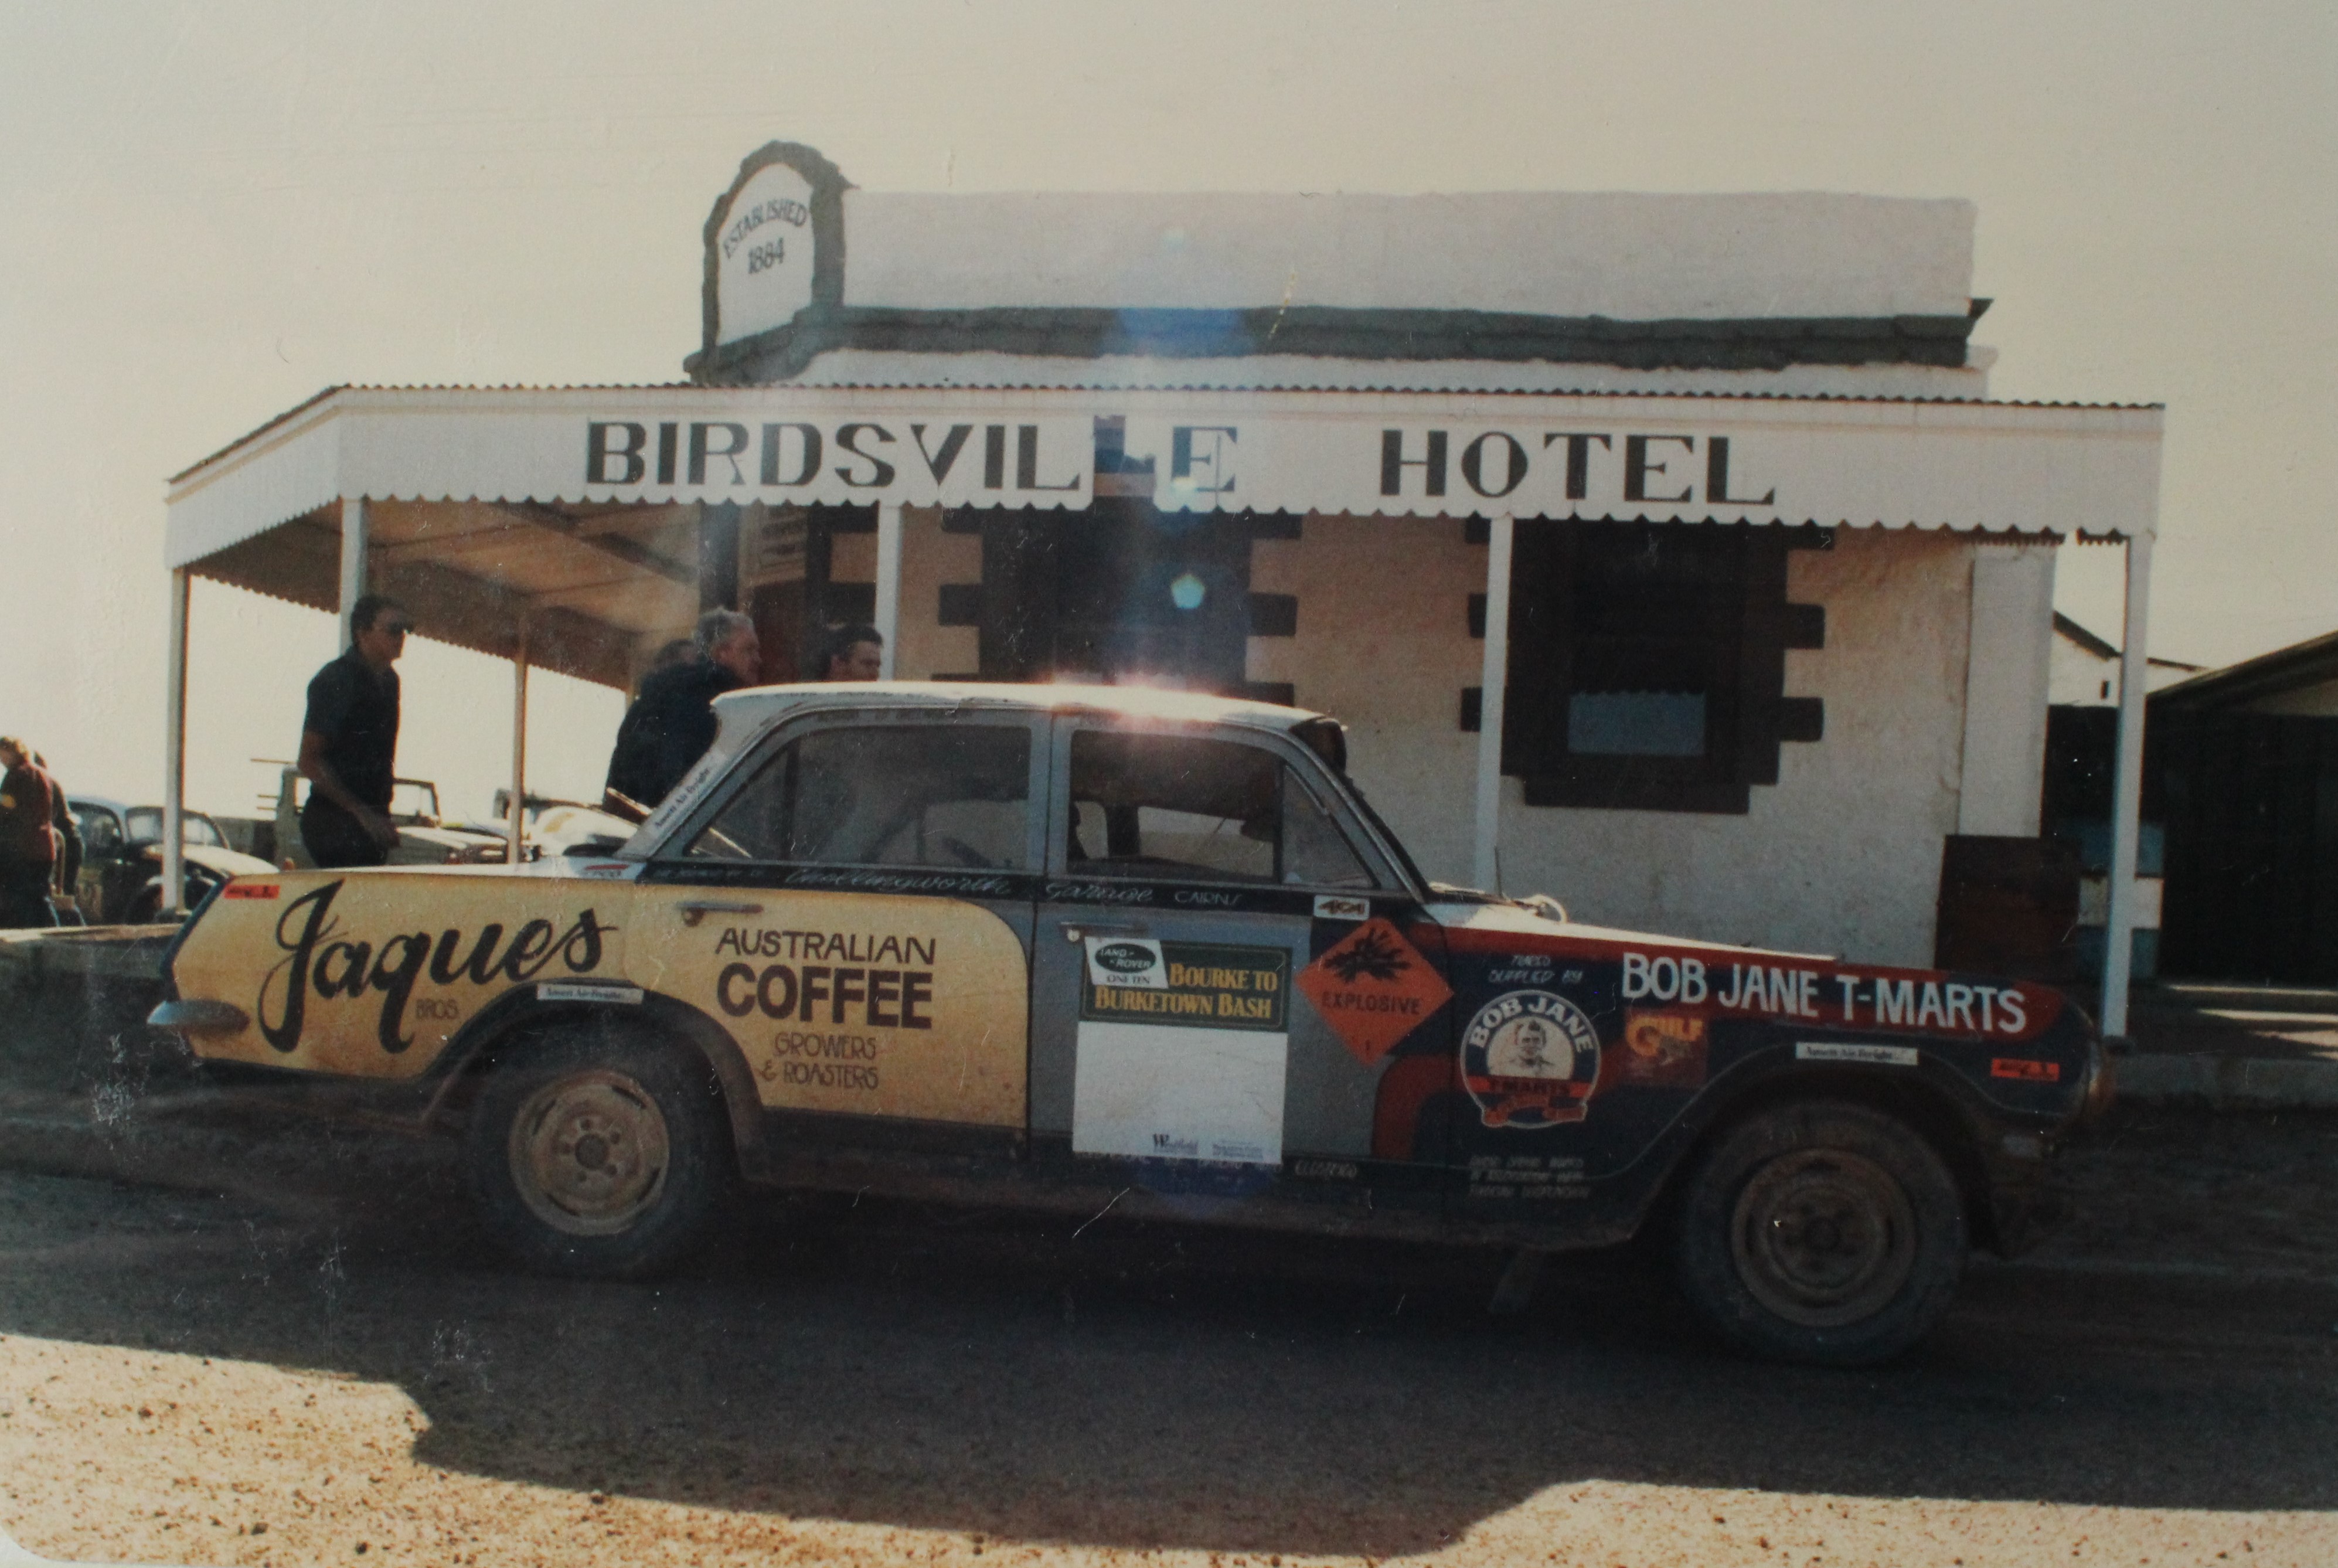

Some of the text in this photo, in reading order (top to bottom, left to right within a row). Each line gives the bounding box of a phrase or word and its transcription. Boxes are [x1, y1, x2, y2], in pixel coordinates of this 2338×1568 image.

[722, 199, 808, 259] ESTABLISHED
[747, 237, 785, 274] 1884
[587, 421, 1776, 506] BIRDSVILE HOTEL
[715, 927, 936, 965] AUSTRALIAN
[257, 877, 619, 1055] Jaques
[1169, 962, 1278, 992] BOURKE TO
[717, 962, 933, 1030] COFFEE
[1094, 986, 1272, 1019] BURKETOWN BASH
[1321, 991, 1421, 1015] EXPLOSIVE
[1621, 952, 2027, 1034] BOB JANE T-MARTS
[1469, 995, 1594, 1053] BOB JANE
[774, 1032, 877, 1059] GROWERS
[784, 1062, 879, 1090] ROASTERS
